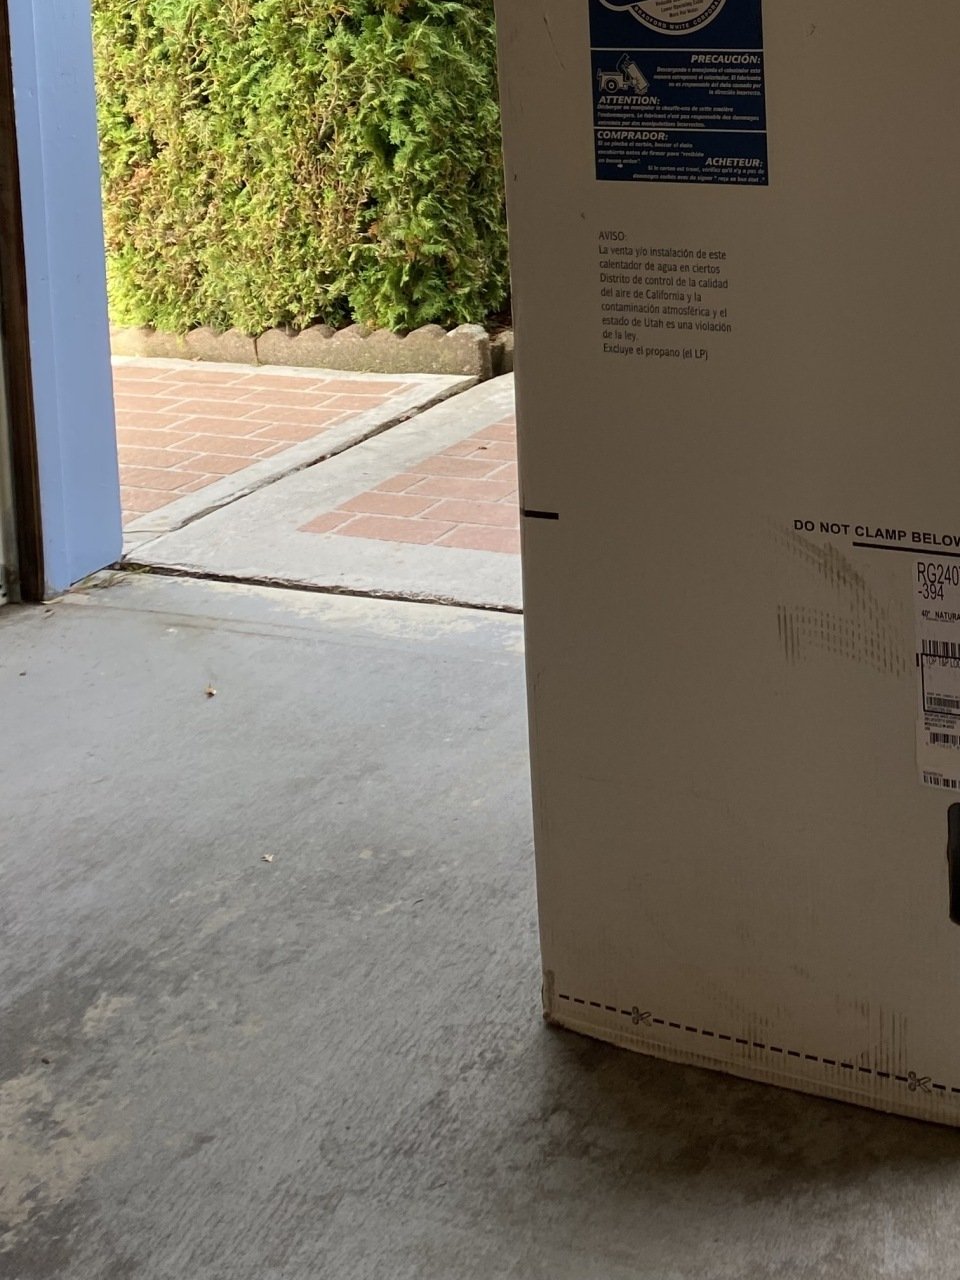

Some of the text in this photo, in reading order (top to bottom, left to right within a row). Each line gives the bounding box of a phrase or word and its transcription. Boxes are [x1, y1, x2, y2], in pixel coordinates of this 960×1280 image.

[690, 53, 761, 64] PRECAUCIÓN:
[598, 96, 660, 105] ATTENTION:
[597, 131, 669, 140] COMPRADOR:
[705, 157, 763, 167] ACHETEUR:
[598, 245, 608, 254] La
[610, 246, 633, 256] venta
[696, 249, 707, 259] de
[709, 250, 727, 260] este
[599, 259, 642, 270] calentador
[644, 261, 655, 271] de
[657, 264, 677, 274] agua
[680, 264, 689, 272] en
[600, 273, 728, 289] Distrito de control de la calidad
[600, 287, 613, 297] del
[633, 288, 644, 298] de
[645, 289, 685, 301] California
[687, 294, 692, 303] y
[694, 292, 702, 302] la
[601, 301, 660, 314] contaminación
[712, 311, 717, 319] y
[719, 307, 728, 317] el
[602, 316, 732, 333] estado de Utah es una violación
[602, 329, 613, 339] de
[615, 331, 622, 340] la
[603, 342, 634, 356] Excluye
[636, 345, 644, 355] el
[646, 347, 680, 358] propano
[793, 519, 815, 531] DO
[819, 522, 850, 535] NOT
[854, 525, 907, 541] CLAMP
[917, 582, 945, 601] -394
